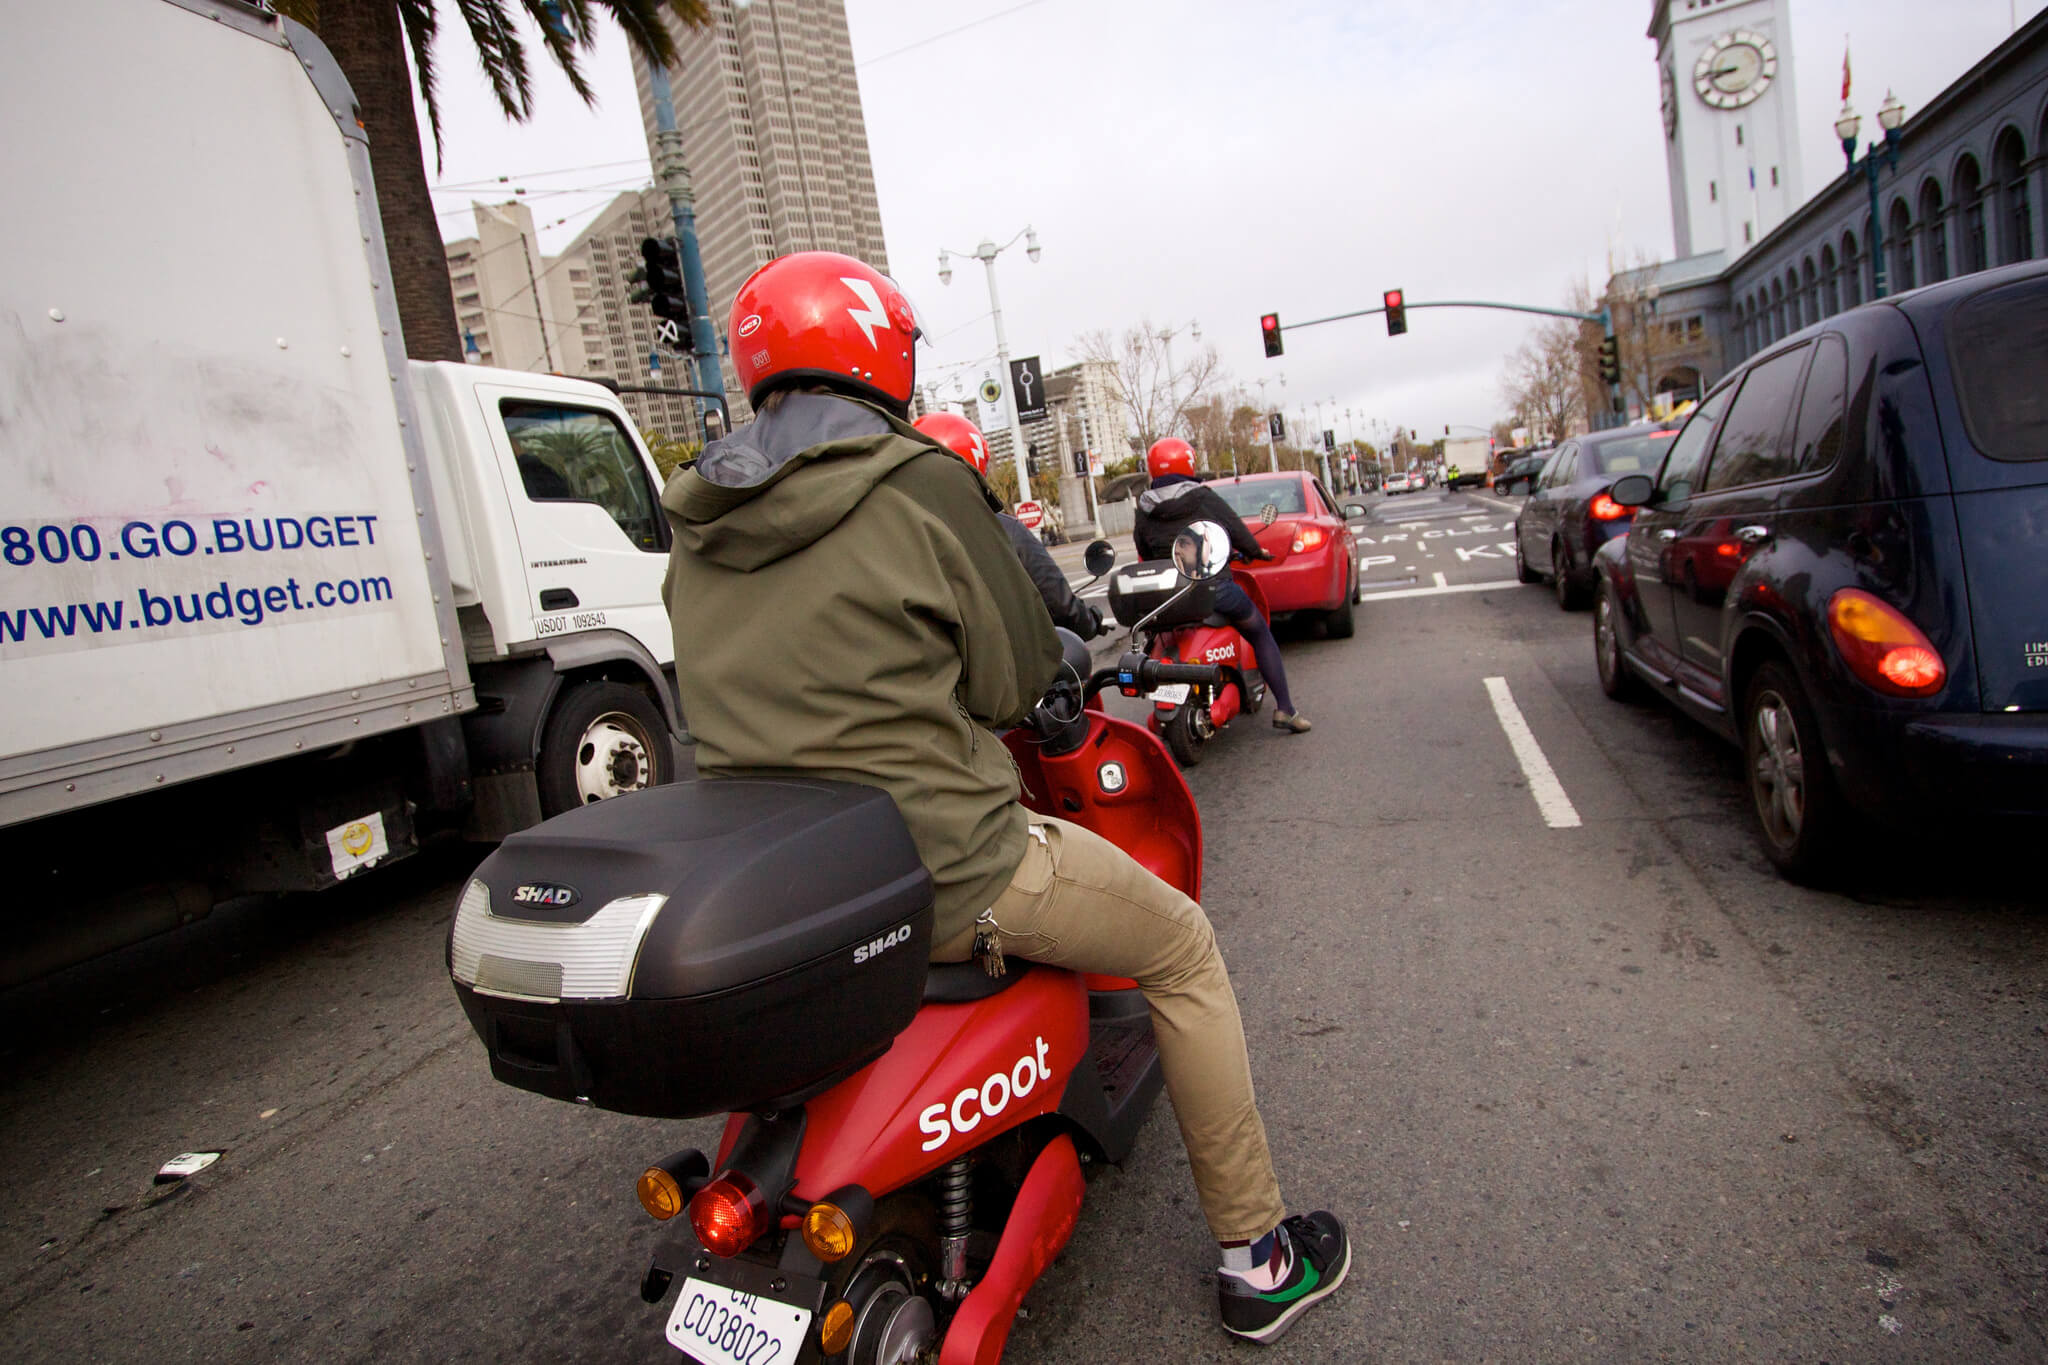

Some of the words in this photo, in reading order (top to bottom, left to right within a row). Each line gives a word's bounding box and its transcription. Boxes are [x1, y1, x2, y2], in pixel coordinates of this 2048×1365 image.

[536, 616, 567, 634] USDOT
[1206, 642, 1235, 661] scoot
[513, 885, 572, 905] SHAD
[853, 924, 912, 964] SH40
[919, 1036, 1051, 1152] scoot
